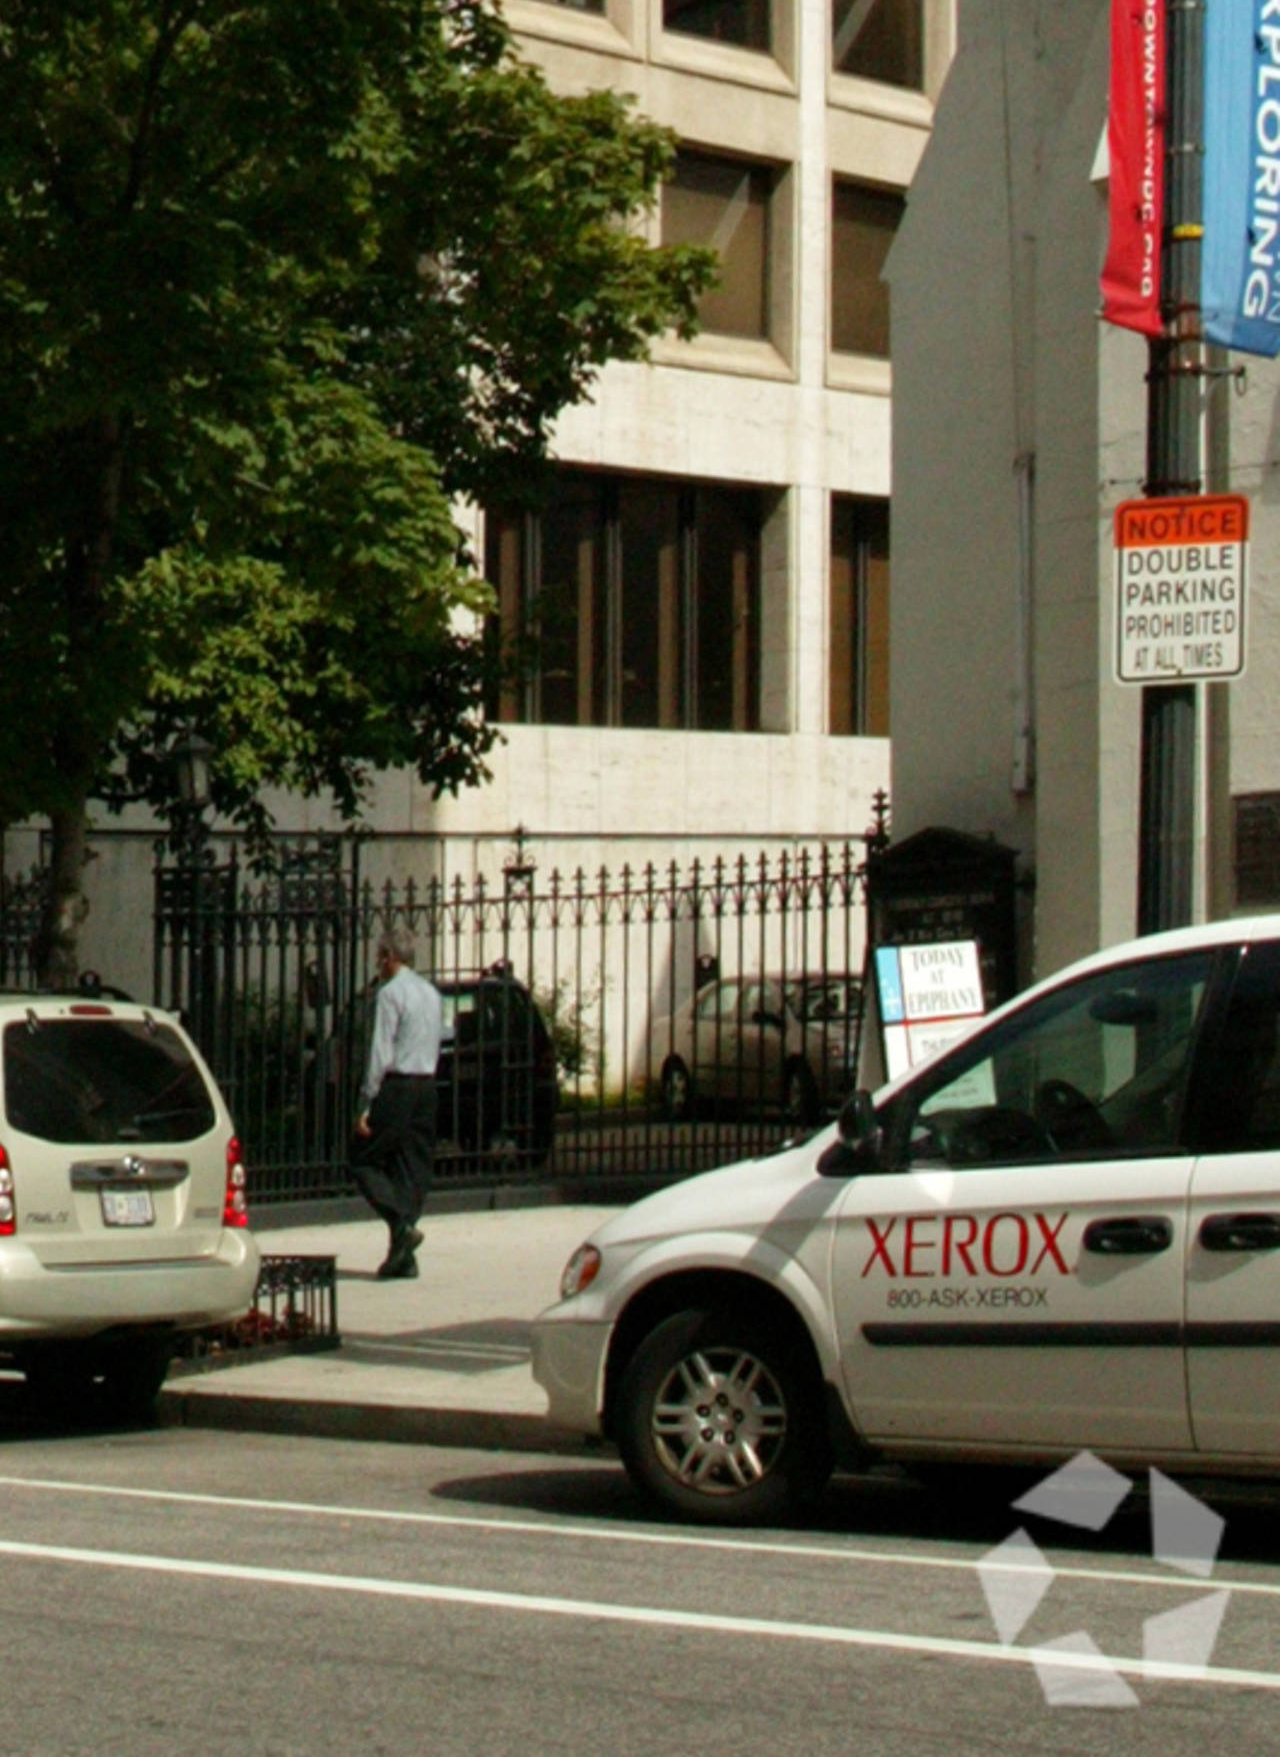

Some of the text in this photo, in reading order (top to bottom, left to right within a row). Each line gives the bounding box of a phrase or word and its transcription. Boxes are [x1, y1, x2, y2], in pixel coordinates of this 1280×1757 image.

[1128, 510, 1237, 540] NOTICE
[1127, 545, 1234, 576] DOUBLE
[1126, 577, 1236, 607] PARKING
[1125, 609, 1236, 639] PROHIBITED
[1134, 641, 1224, 671] AT ALL TIMES
[909, 946, 965, 971] TODAY
[908, 987, 978, 1014] EPIPHANY
[860, 1211, 1070, 1278] XEROX
[887, 1286, 1049, 1309] 800-ASK-XEROX
